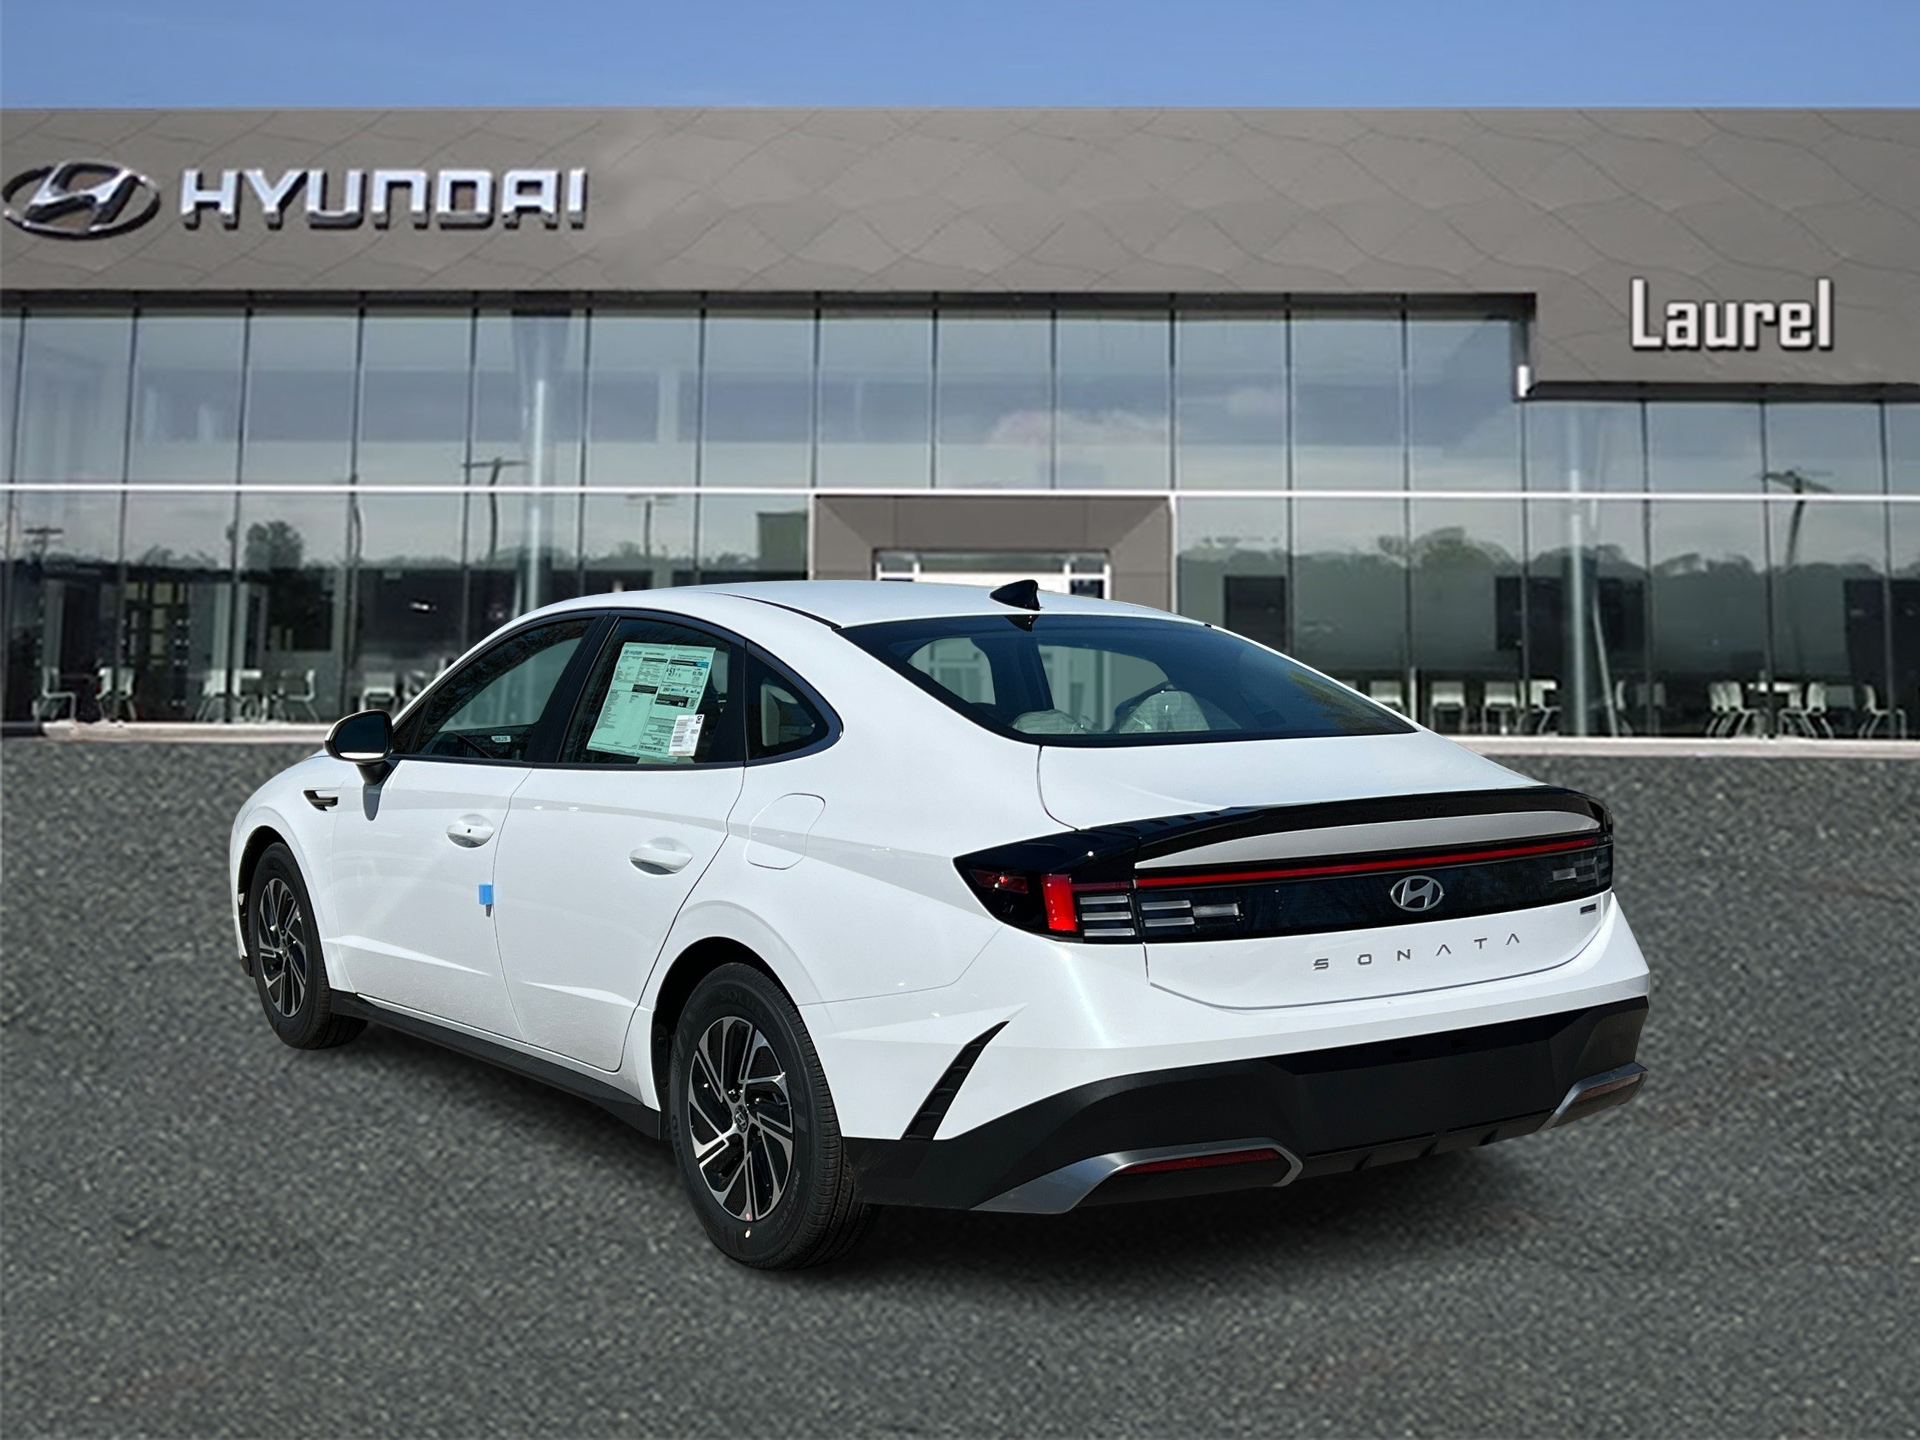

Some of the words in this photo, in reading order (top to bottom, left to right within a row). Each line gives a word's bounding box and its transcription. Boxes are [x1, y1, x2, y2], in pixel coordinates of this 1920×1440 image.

[180, 169, 587, 230] HYUNDAI
[1631, 278, 1833, 350] Laurel
[1313, 932, 1521, 971] SONATA
